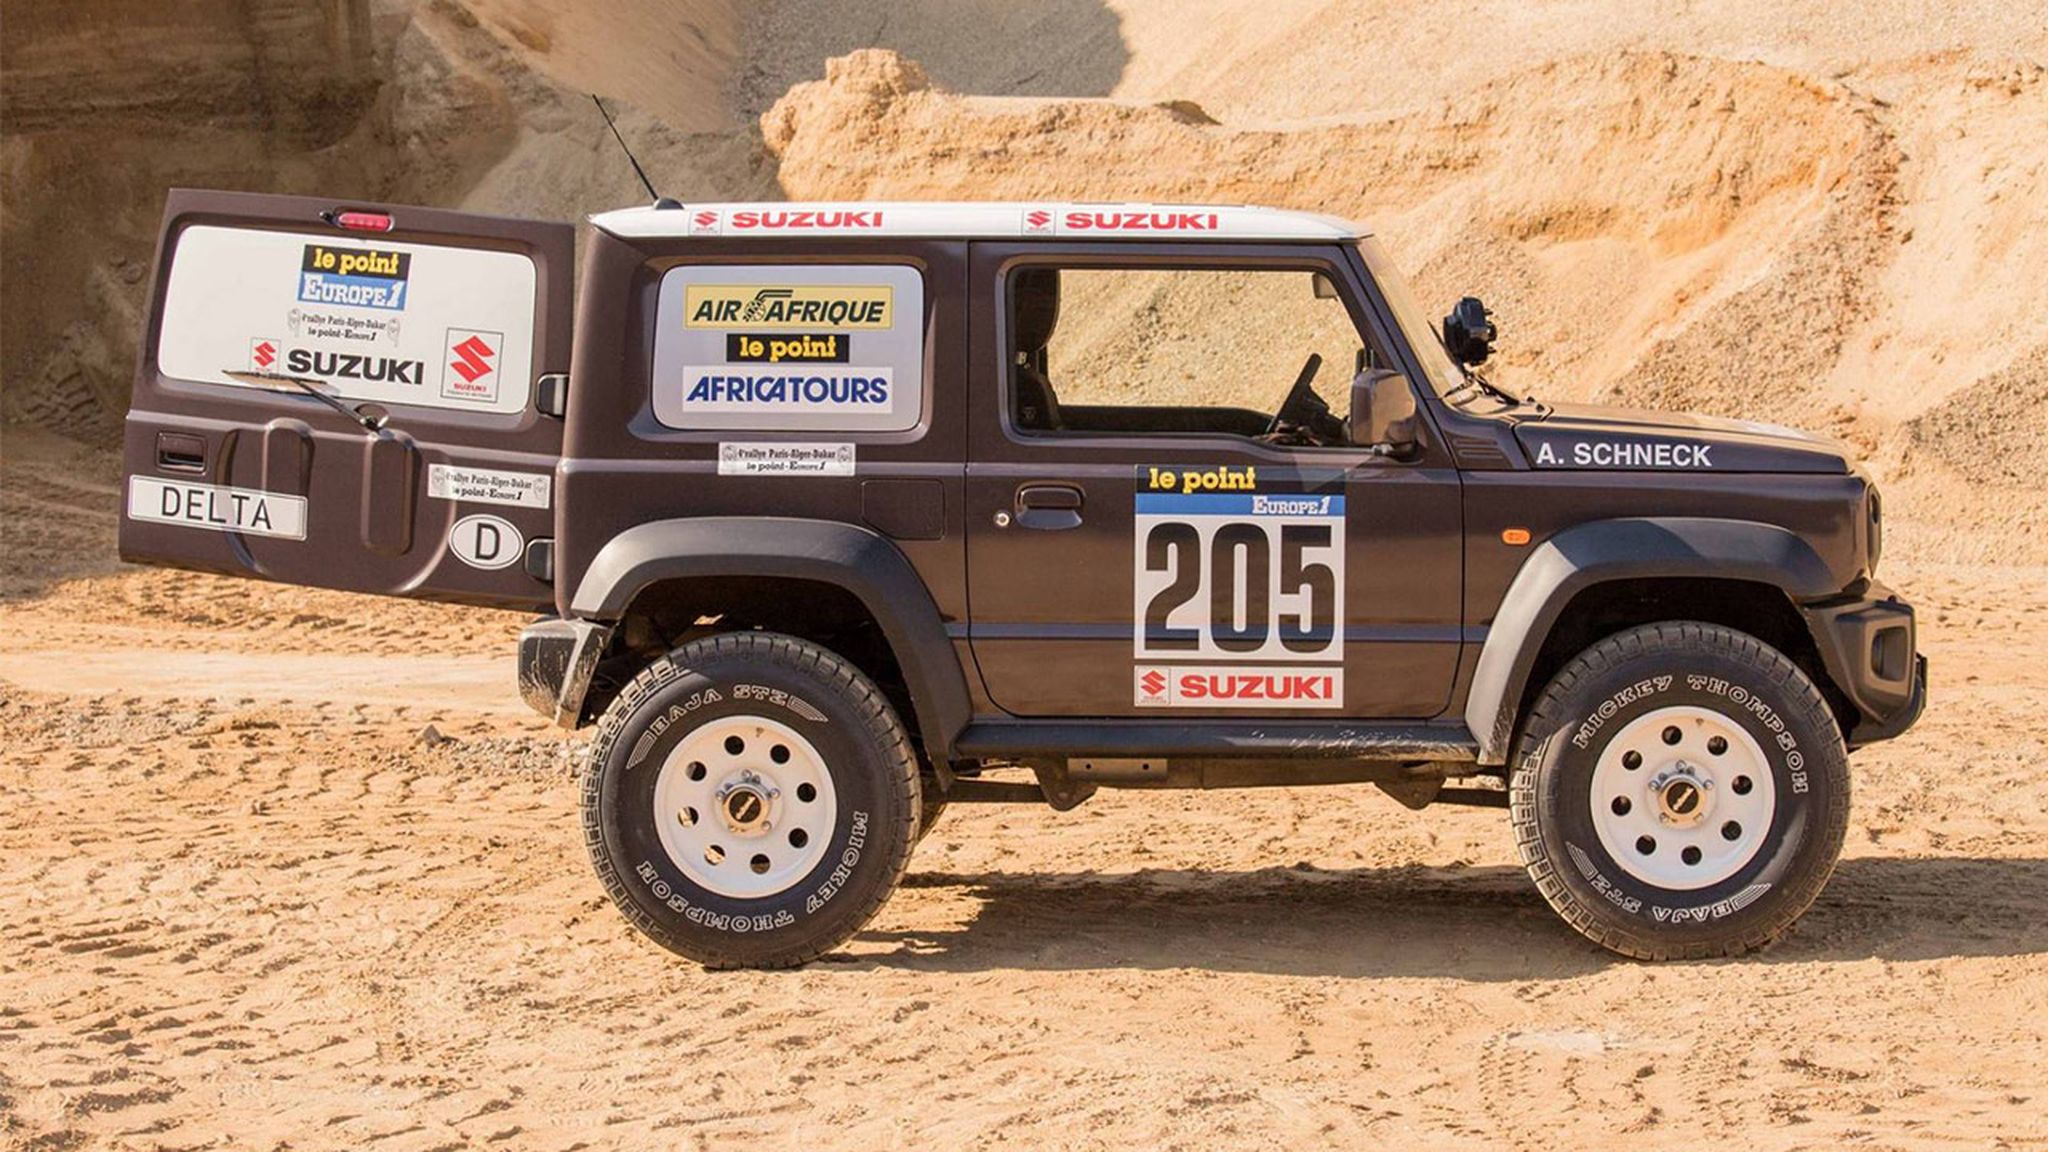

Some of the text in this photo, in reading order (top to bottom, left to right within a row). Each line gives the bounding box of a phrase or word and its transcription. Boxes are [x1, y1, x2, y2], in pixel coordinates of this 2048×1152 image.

[732, 211, 883, 228] SUZUKI
[1065, 212, 1218, 229] SUZUKI
[313, 247, 399, 275] le point
[692, 300, 886, 326] AIR AFRIQUE
[739, 335, 837, 363] le point
[287, 349, 425, 385] SUZUKI
[453, 383, 487, 393] SUZUKI
[686, 376, 888, 404] AFRICATOURS
[1536, 442, 1713, 467] A. SCHNECK
[1149, 466, 1256, 494] le point
[161, 486, 272, 531] DELTA
[475, 522, 500, 561] D
[1144, 521, 1337, 654] 205
[1180, 675, 1333, 699] SUZUKI
[649, 684, 789, 737] BAJA STZ
[1572, 674, 1809, 794] MICKEY THOMPSON
[636, 810, 869, 933] MICKEY THOMPSON
[1651, 902, 1731, 924] BAJA
